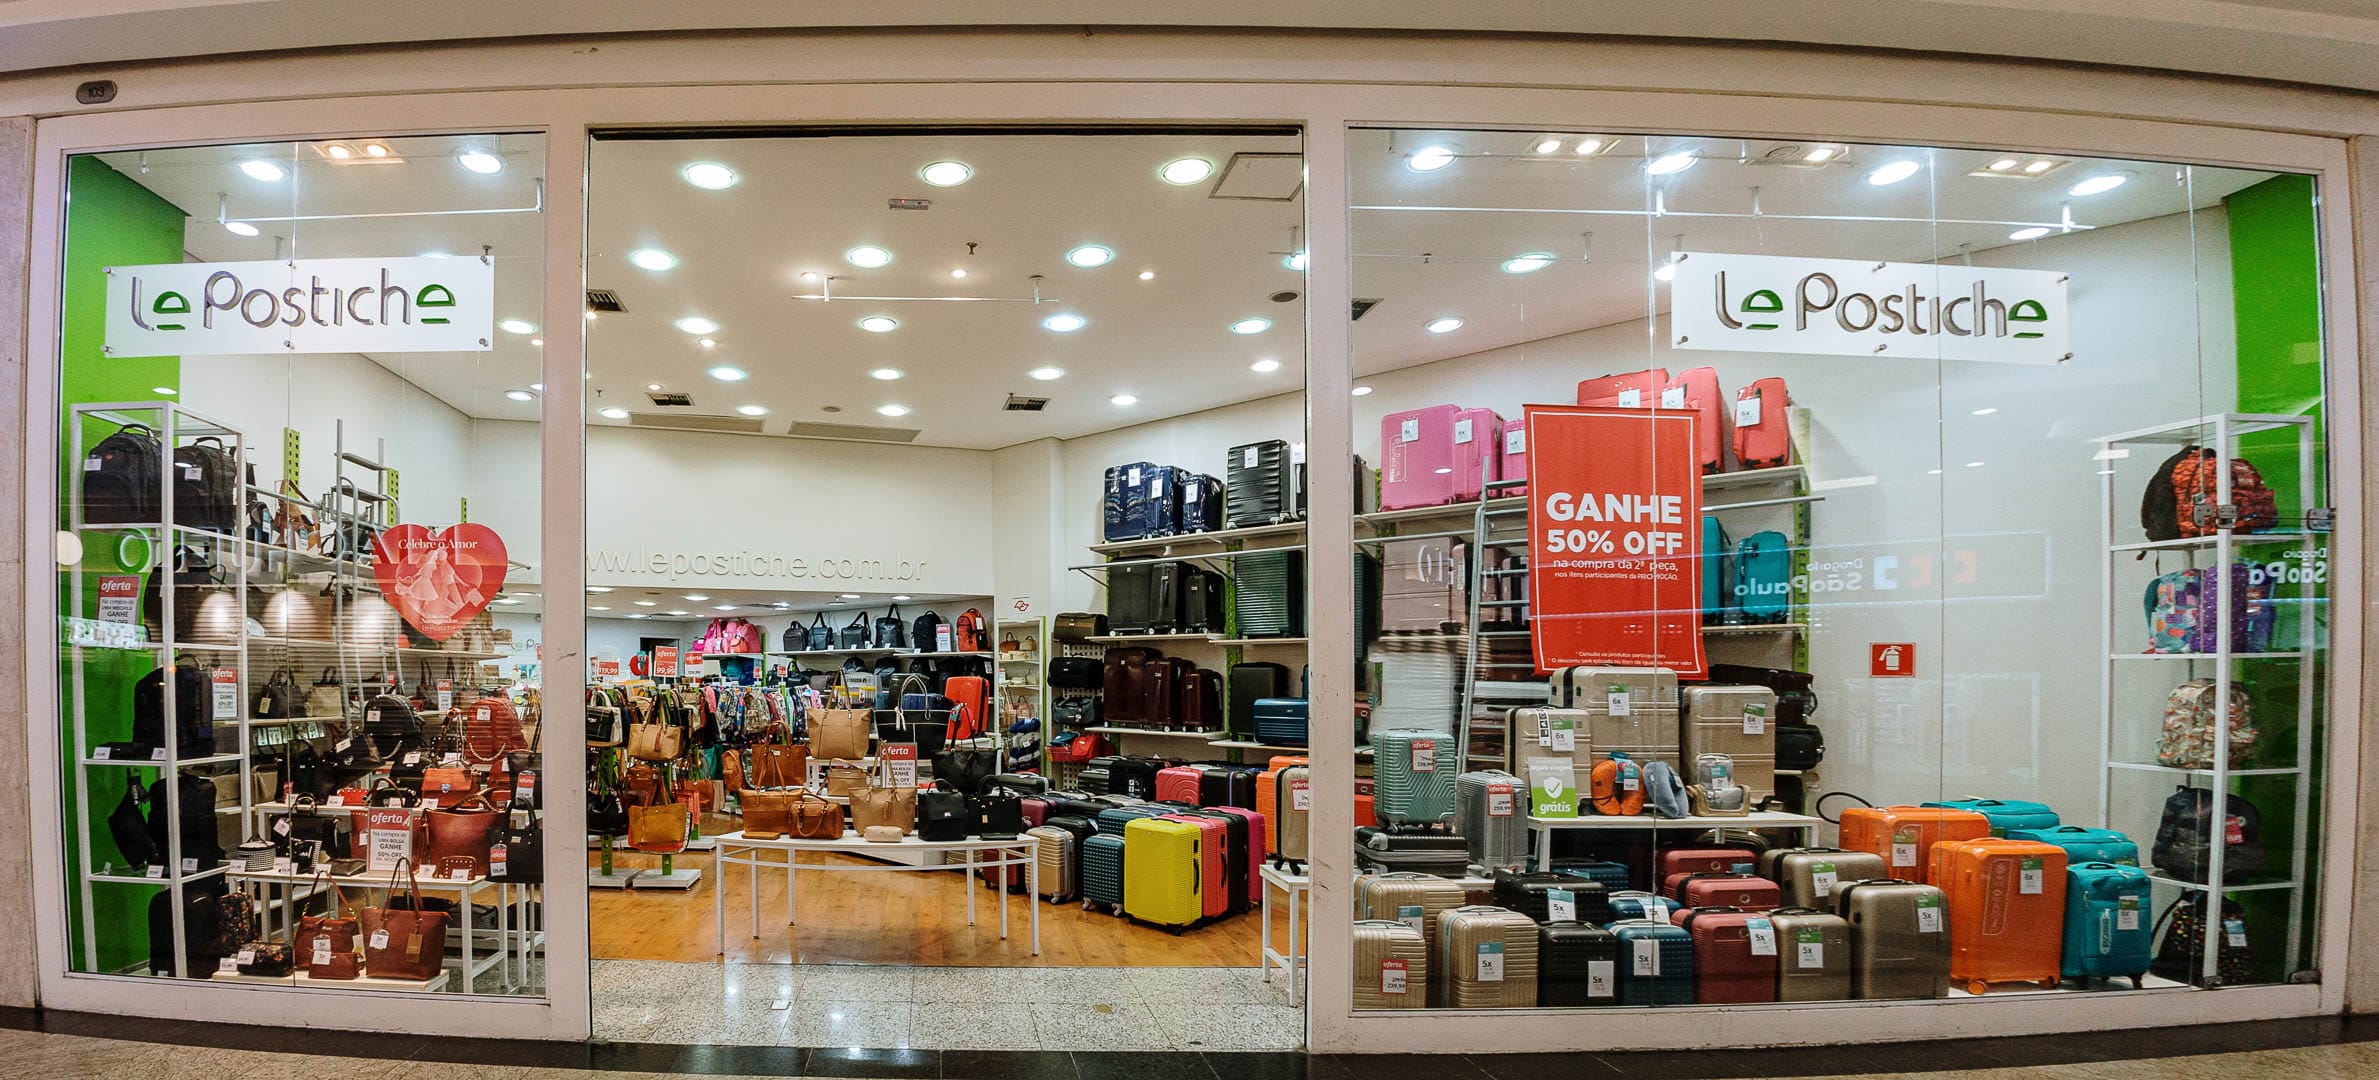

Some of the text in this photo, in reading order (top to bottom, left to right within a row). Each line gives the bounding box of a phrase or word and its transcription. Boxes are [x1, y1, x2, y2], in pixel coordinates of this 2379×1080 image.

[88, 86, 105, 98] 103
[132, 268, 456, 331] Le Postiche
[1715, 271, 2048, 338] Le Postiche
[1546, 492, 1681, 524] GANHE
[398, 539, 477, 549] Celebre o Amor
[1547, 529, 1683, 555] 50% OFF
[1554, 560, 1678, 571] na compra da 2ª peça,
[101, 580, 131, 592] oferta
[213, 669, 233, 679] oferta
[882, 747, 909, 755] oferta
[1540, 801, 1571, 814] grátis
[371, 813, 402, 824] oferta
